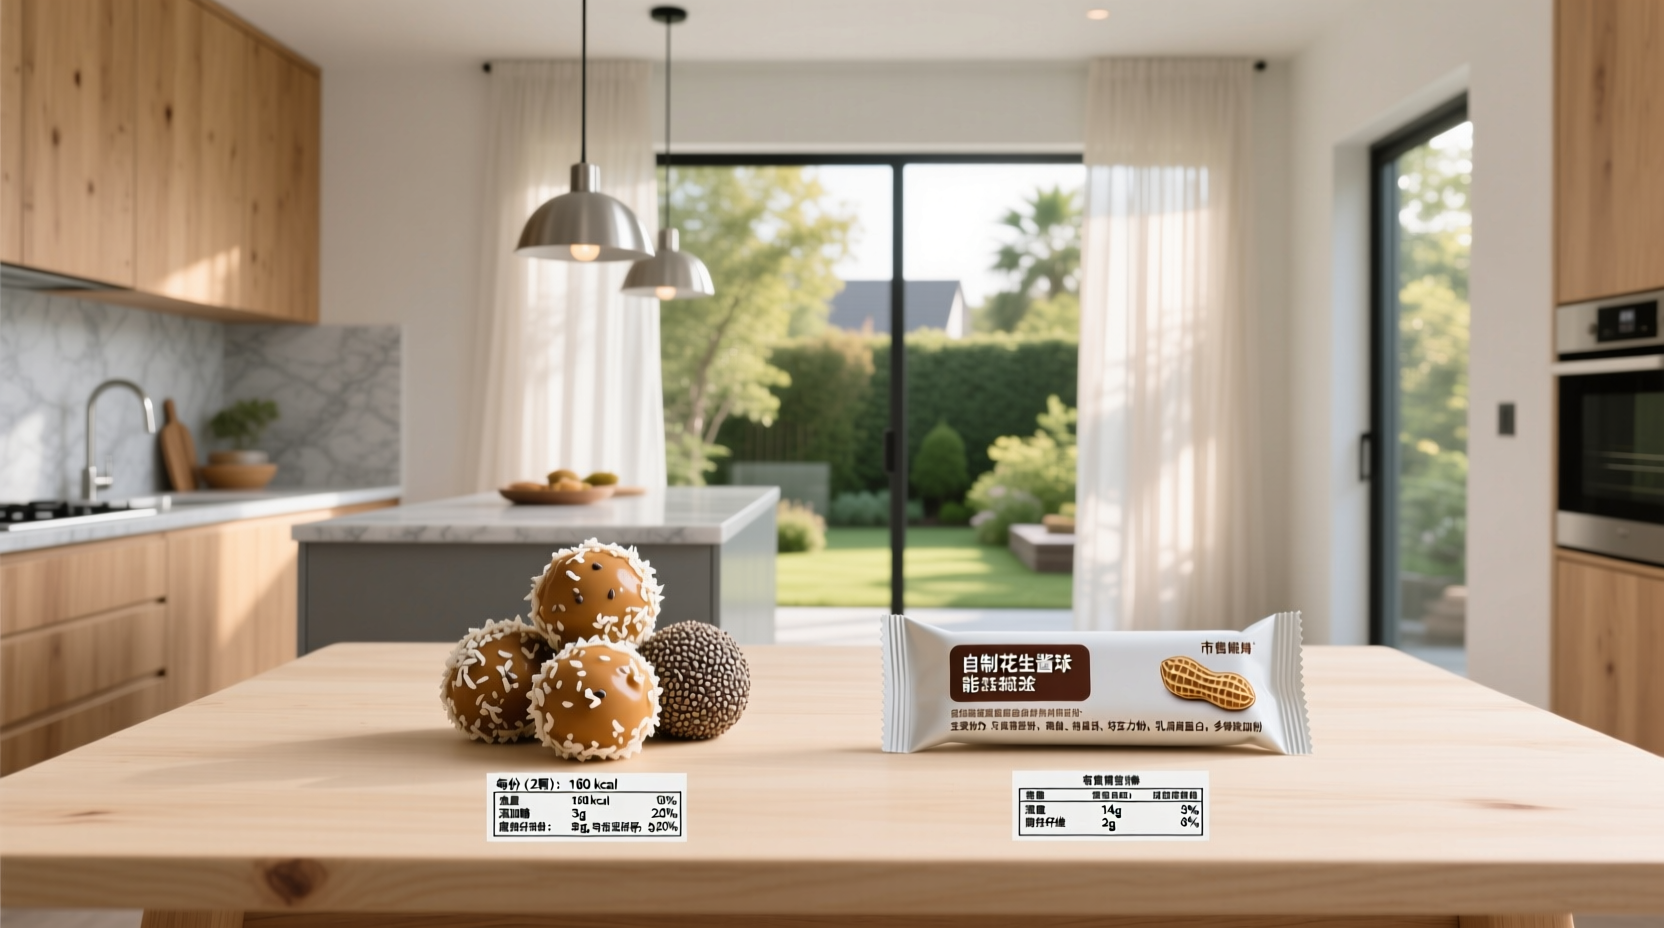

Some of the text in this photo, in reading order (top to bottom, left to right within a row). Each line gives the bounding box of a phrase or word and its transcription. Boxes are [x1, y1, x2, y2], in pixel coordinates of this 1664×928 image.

[569, 778, 591, 790] 160
[594, 778, 618, 790] kcal
[1101, 804, 1122, 818] 14g
[1101, 818, 1116, 831] 2g
